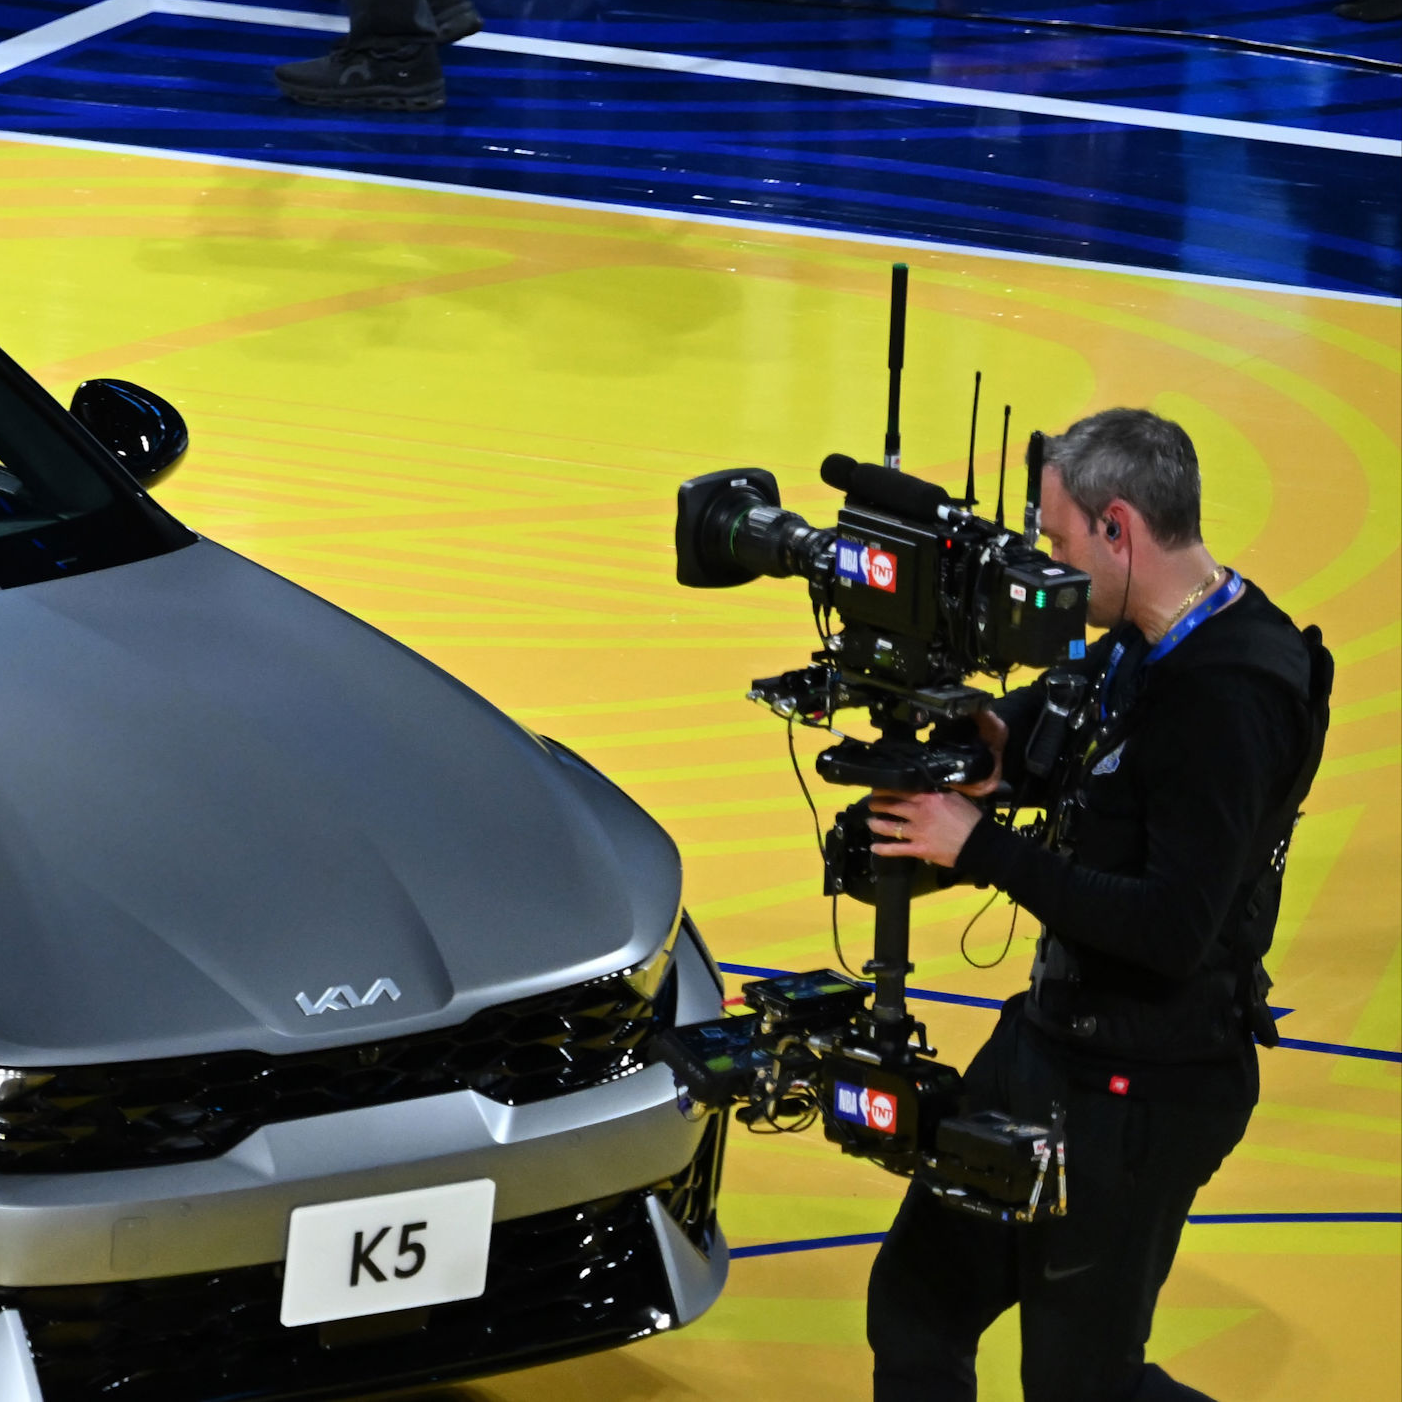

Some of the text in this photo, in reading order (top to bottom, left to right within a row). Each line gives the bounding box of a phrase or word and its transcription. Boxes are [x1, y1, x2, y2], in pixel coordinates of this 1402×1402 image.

[840, 547, 893, 580] NBA TNT
[295, 977, 402, 1016] KIA
[838, 1088, 893, 1119] NBA TNT
[348, 1221, 428, 1288] K5
